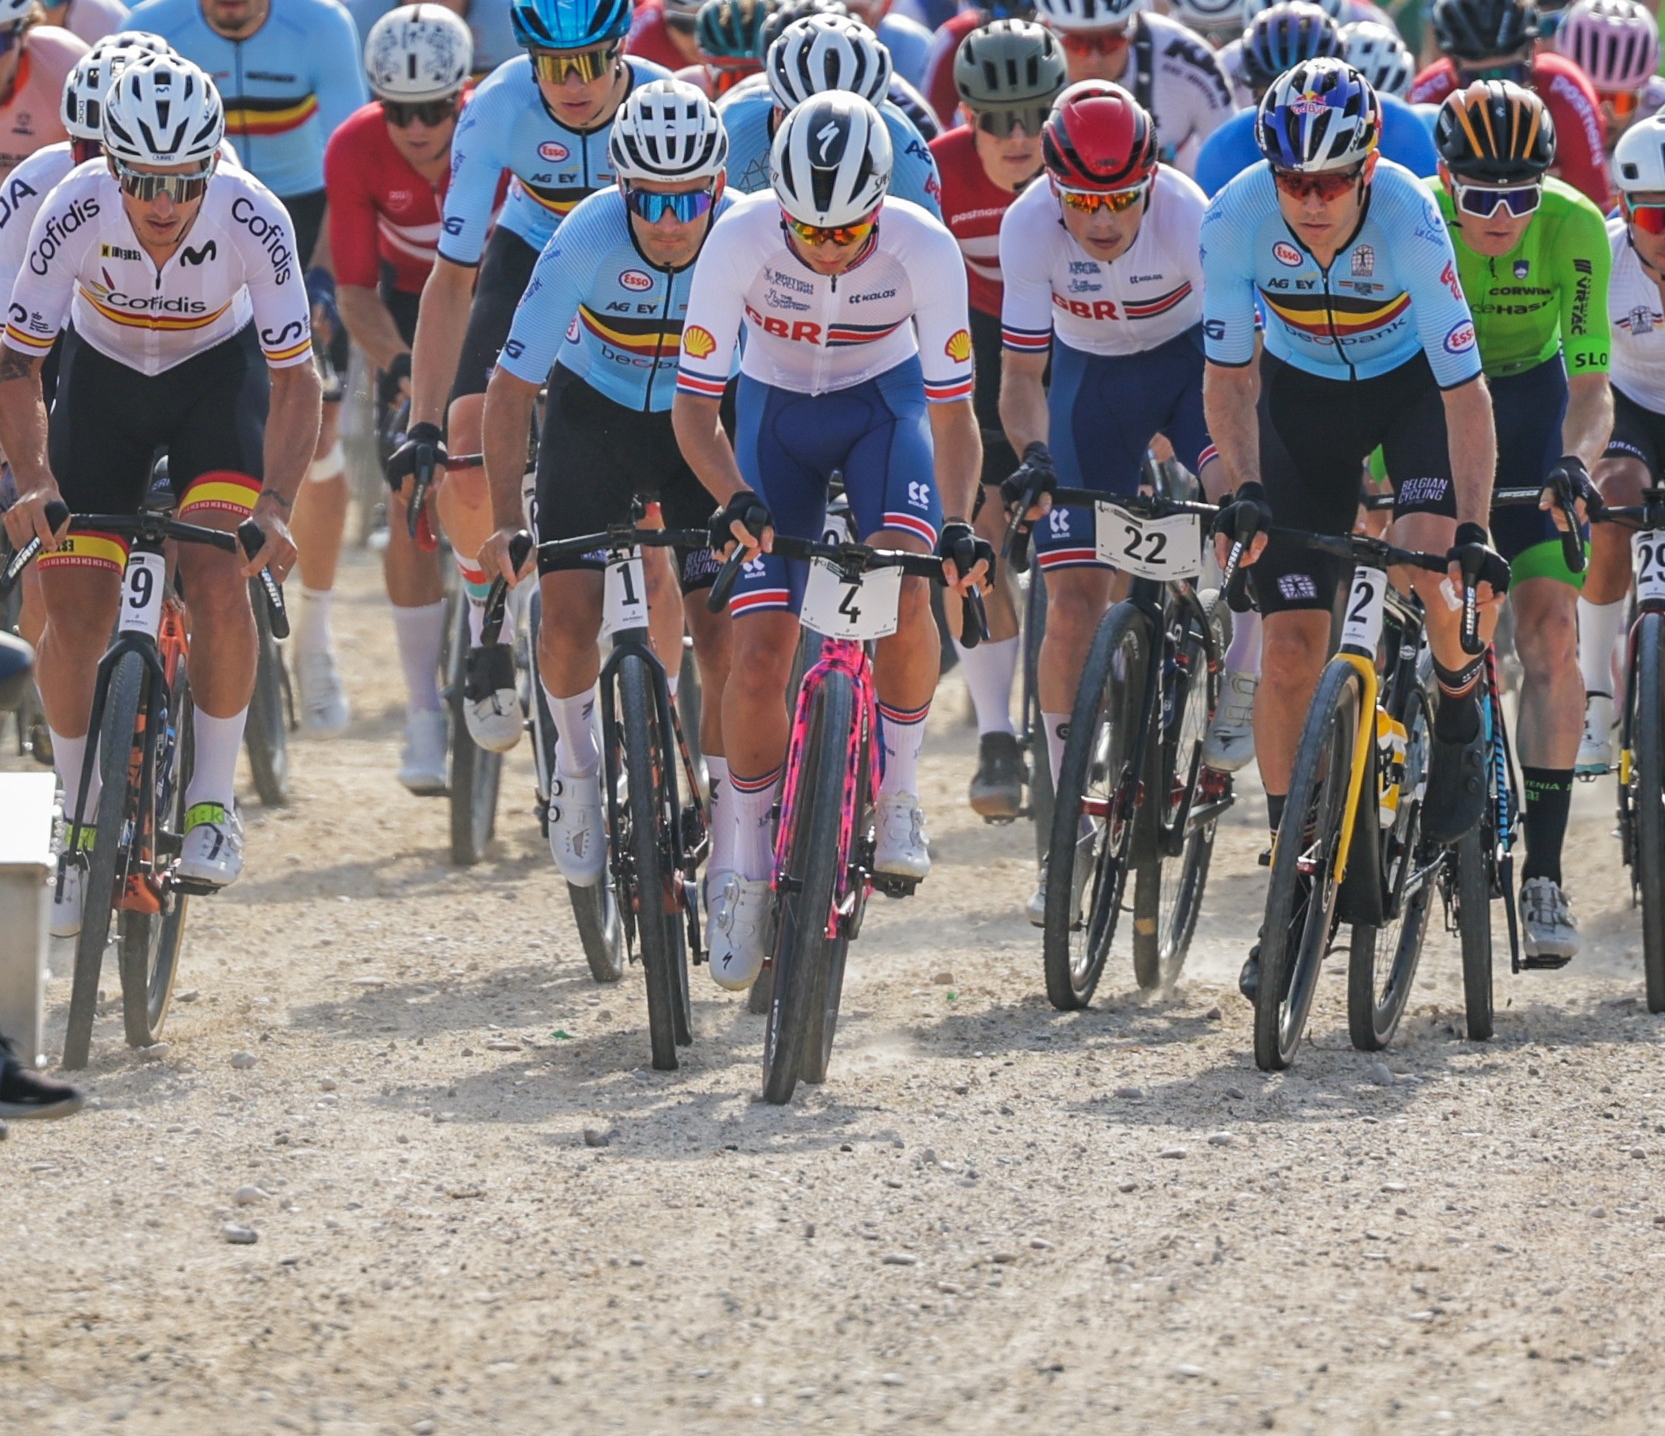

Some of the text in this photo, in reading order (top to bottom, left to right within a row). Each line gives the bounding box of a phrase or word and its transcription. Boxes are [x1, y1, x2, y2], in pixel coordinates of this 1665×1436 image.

[530, 173, 578, 183] AG EY
[951, 206, 1007, 225] postnor
[30, 197, 101, 276] Cofidis
[231, 197, 292, 286] Cofidis
[1275, 246, 1300, 262] Esso
[624, 275, 649, 287] Esso
[1268, 277, 1316, 290] AG EY
[106, 292, 207, 314] Cofidis
[605, 301, 658, 314] AG EY
[1052, 292, 1121, 321] GBR
[745, 304, 823, 345] GBR
[1286, 318, 1407, 346] beobank
[1575, 352, 1608, 368] SLO
[1398, 487, 1447, 505] CYCLING
[1402, 477, 1448, 492] BELGIAN
[8, 537, 42, 578] SRAM
[686, 550, 714, 566] BELGIA
[1123, 525, 1167, 564] 22
[128, 566, 154, 609] 9
[616, 562, 640, 606] 1
[838, 585, 862, 624] 4
[1347, 580, 1375, 625] 2
[1465, 586, 1476, 635] SRAM
